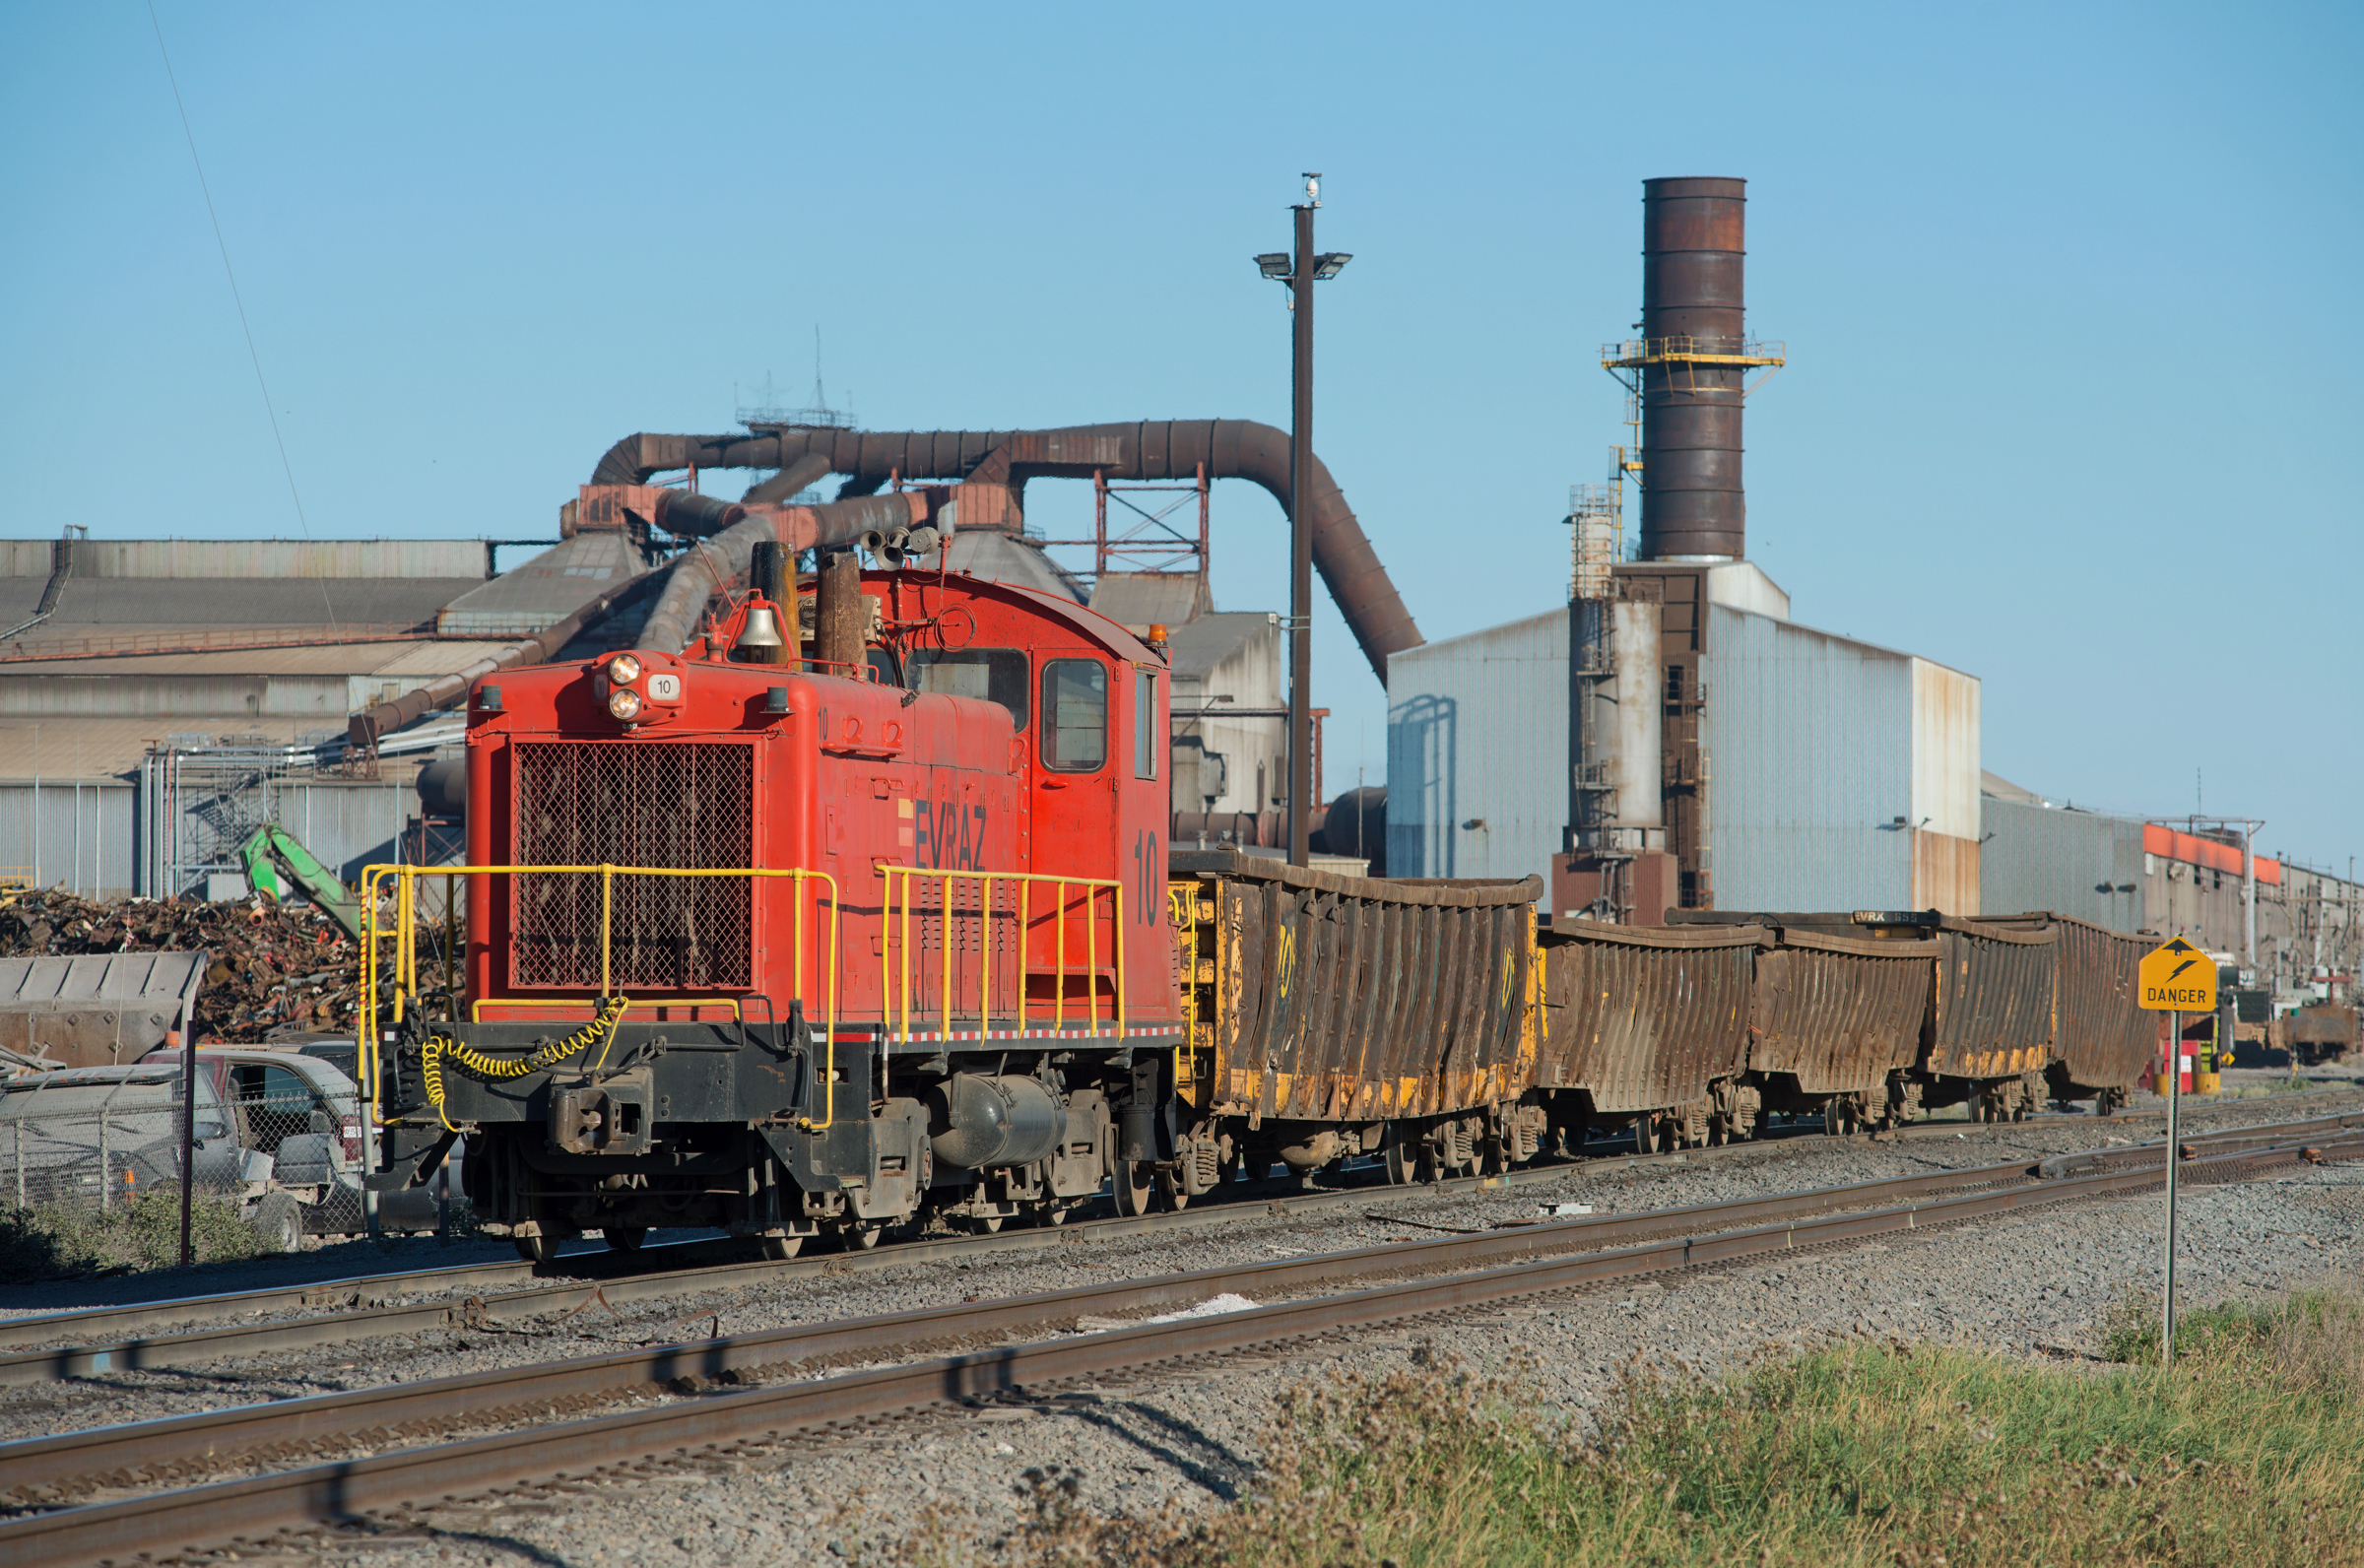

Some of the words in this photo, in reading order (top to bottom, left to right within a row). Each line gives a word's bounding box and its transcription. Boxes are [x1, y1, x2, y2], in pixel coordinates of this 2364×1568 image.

[658, 680, 671, 693] 10
[818, 706, 828, 741] 10
[915, 799, 987, 872] EVRAZ
[1135, 828, 1158, 928] 10
[2147, 987, 2206, 1004] DANGER
